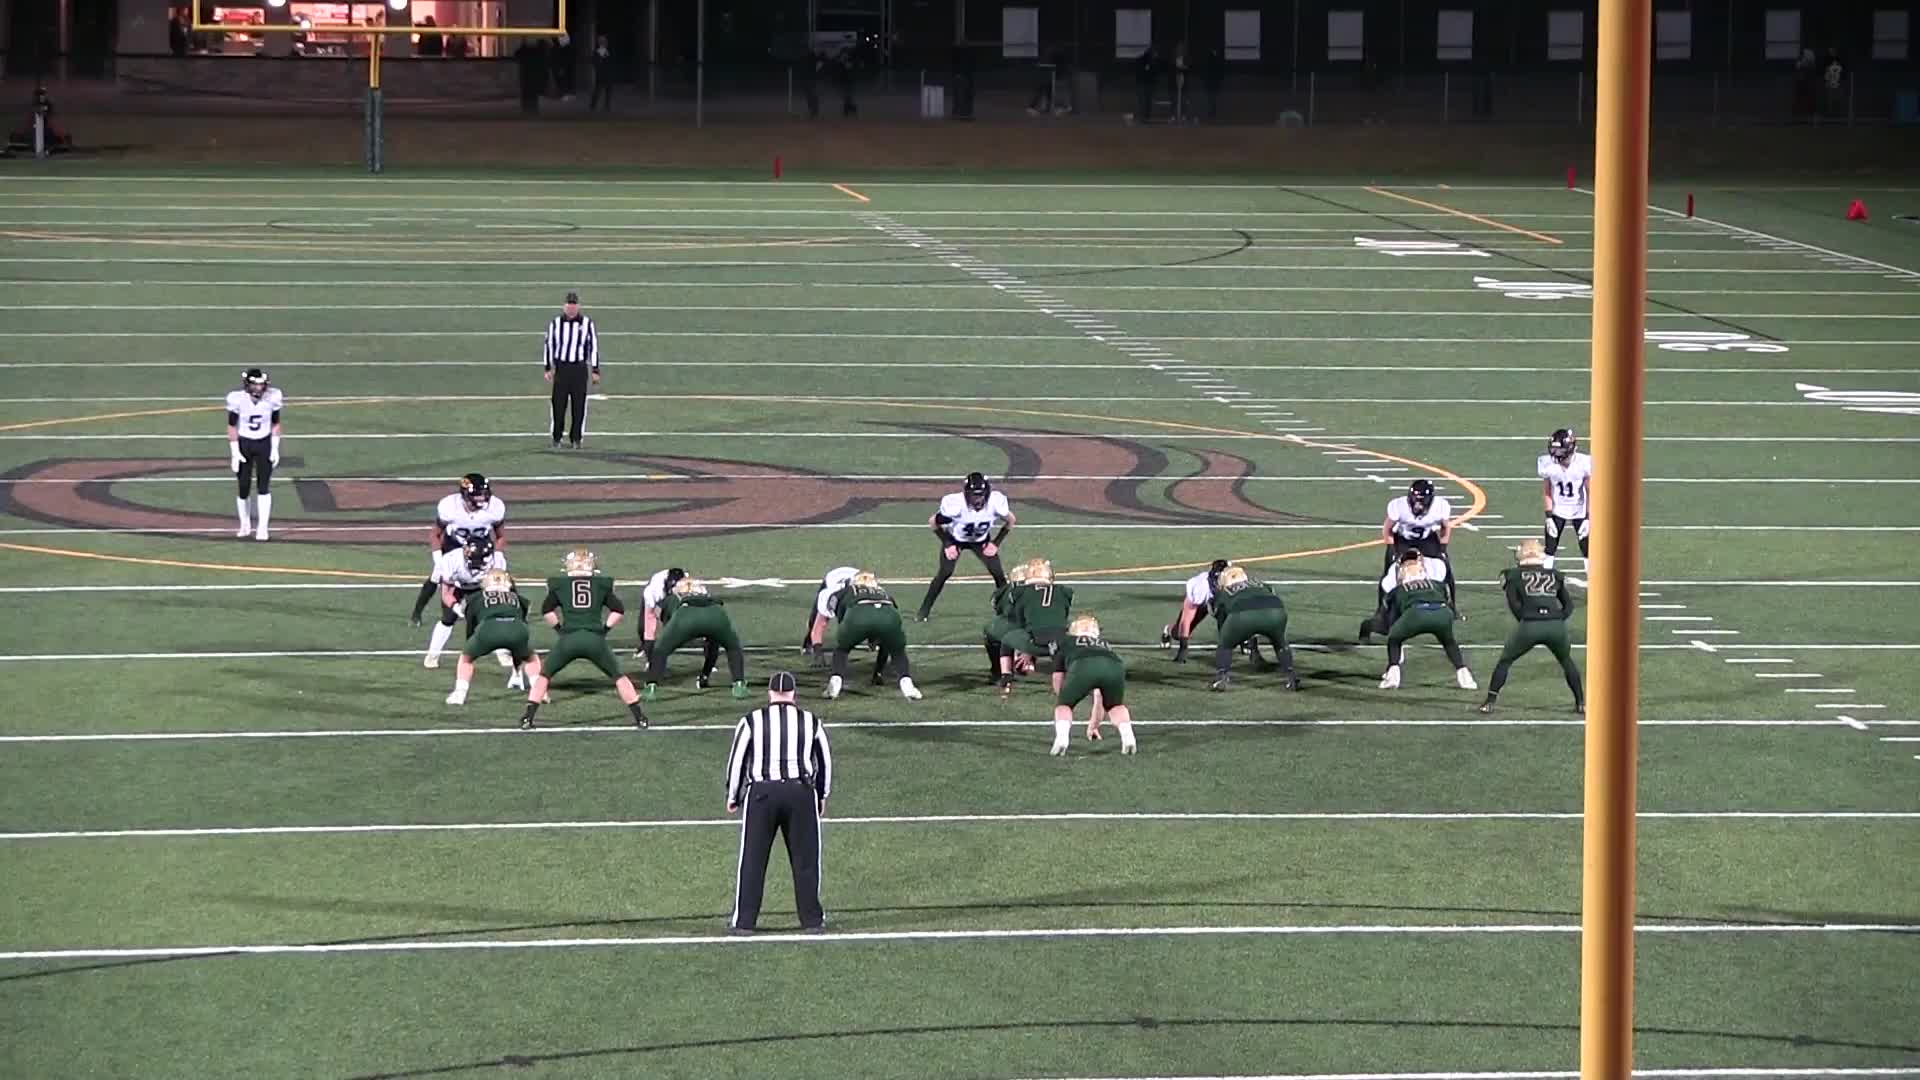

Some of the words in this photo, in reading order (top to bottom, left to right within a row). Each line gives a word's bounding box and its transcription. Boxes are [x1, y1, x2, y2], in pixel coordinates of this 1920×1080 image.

[248, 414, 263, 432] 5
[1556, 480, 1575, 498] 11
[572, 579, 593, 609] 6
[1034, 583, 1054, 607] 7
[1521, 570, 1557, 597] 22
